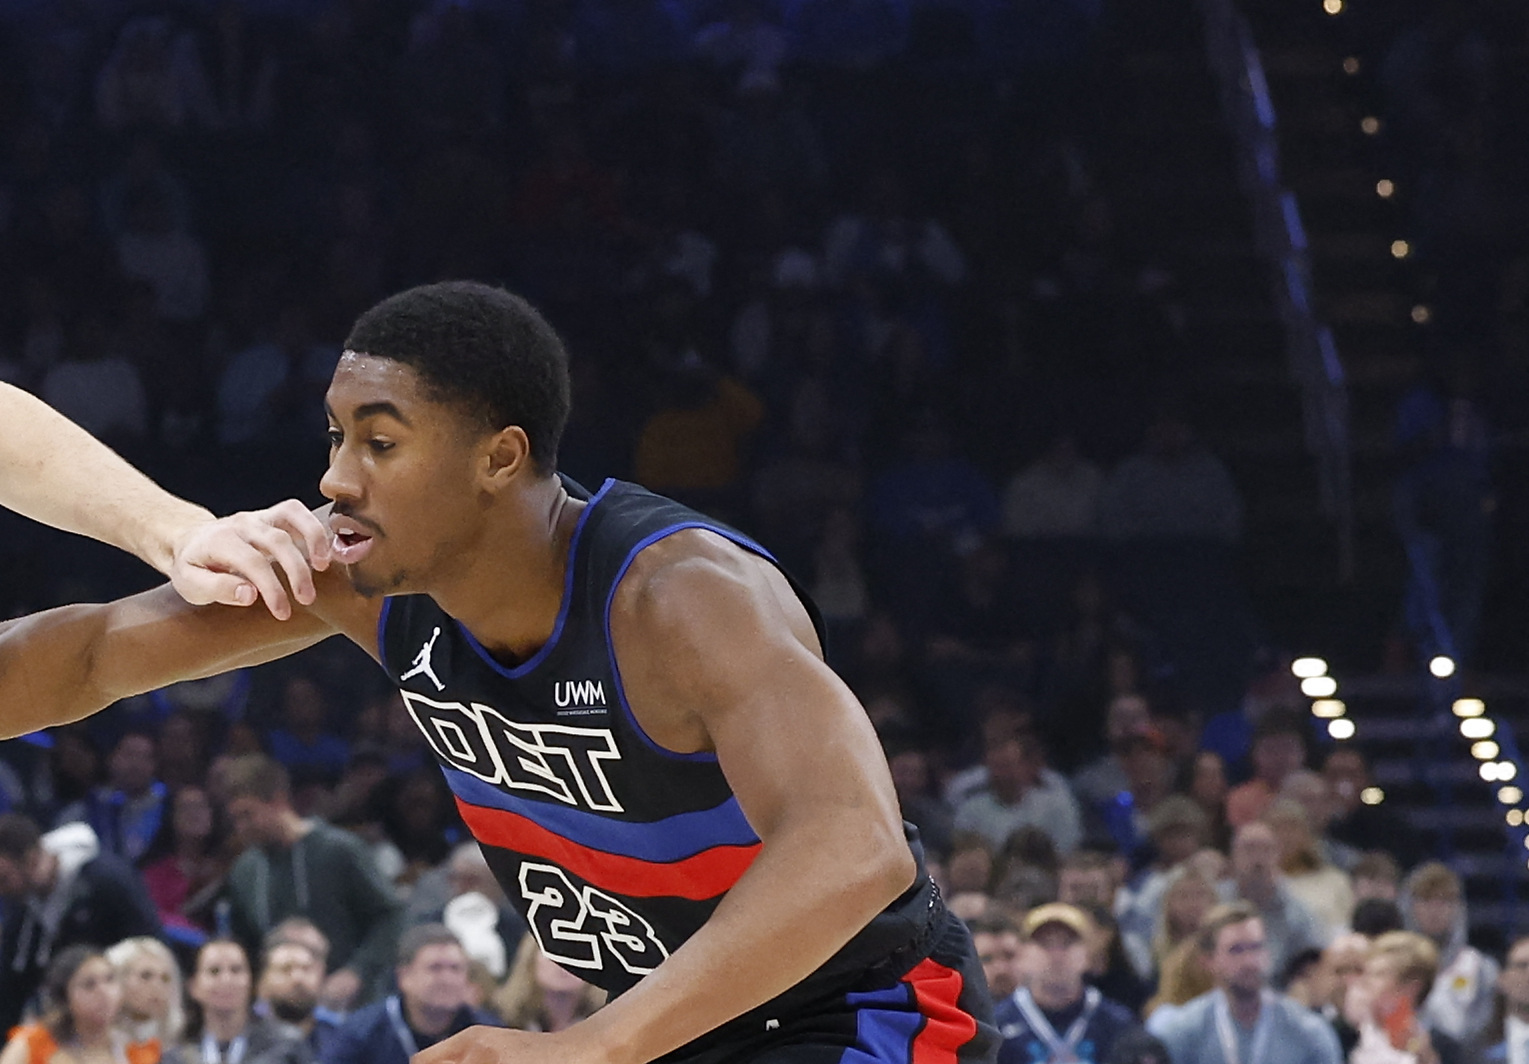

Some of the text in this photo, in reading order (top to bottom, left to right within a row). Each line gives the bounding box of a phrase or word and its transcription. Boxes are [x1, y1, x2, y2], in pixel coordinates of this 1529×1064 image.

[555, 680, 606, 706] UWM
[400, 689, 624, 812] DET
[518, 862, 670, 975] 23
